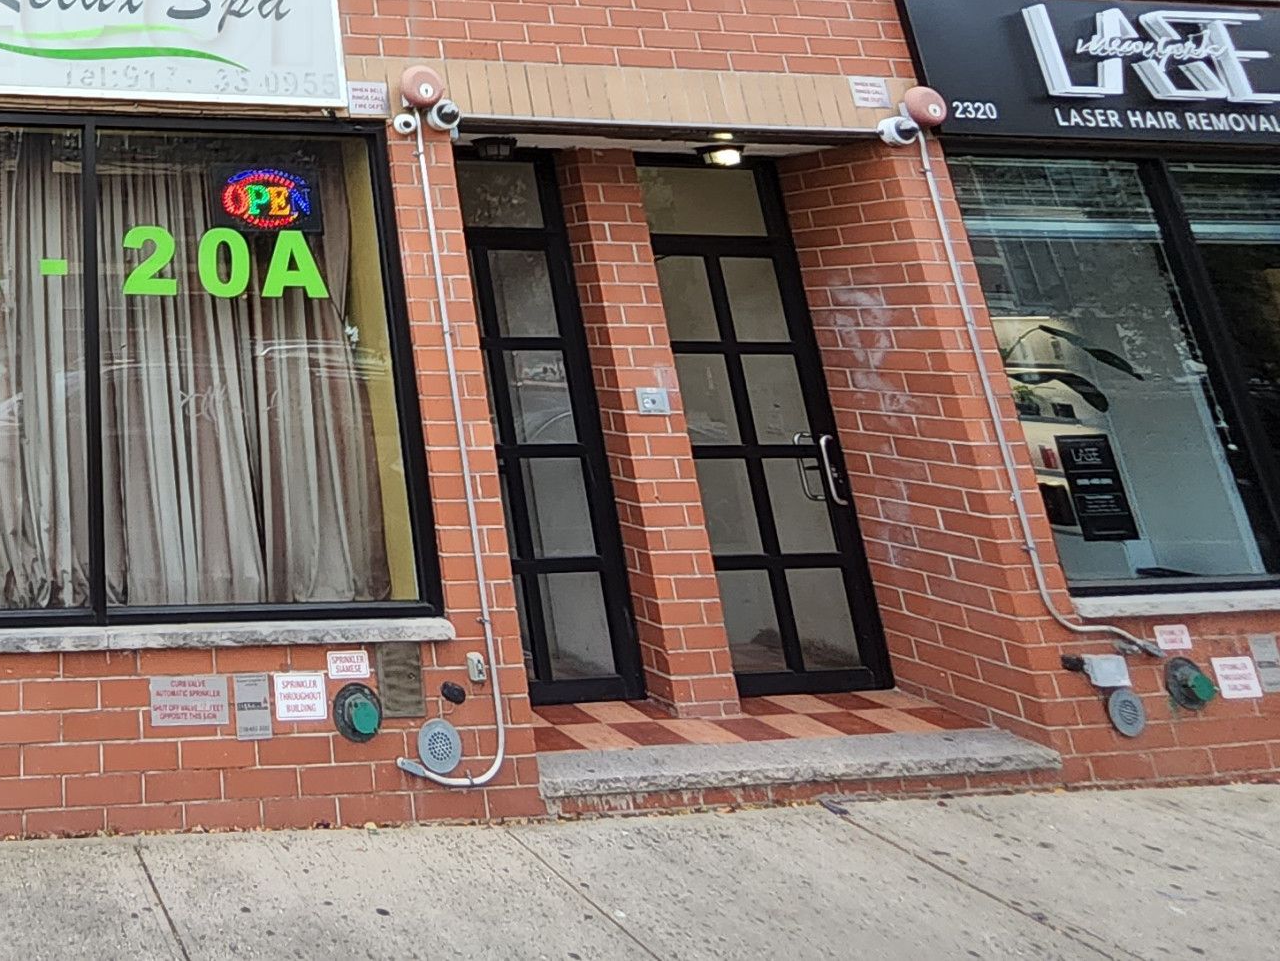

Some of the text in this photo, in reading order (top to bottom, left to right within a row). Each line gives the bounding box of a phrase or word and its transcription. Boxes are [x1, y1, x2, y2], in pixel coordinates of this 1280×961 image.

[952, 101, 997, 119] 2320
[1053, 107, 1280, 133] LASER HAIR REMOVAL
[223, 181, 311, 218] OPEN
[331, 655, 364, 664] SPRINKLER
[282, 679, 318, 689] SPRINKLER
[280, 692, 321, 701] THROUGHOUT
[286, 704, 316, 713] BUILDING
